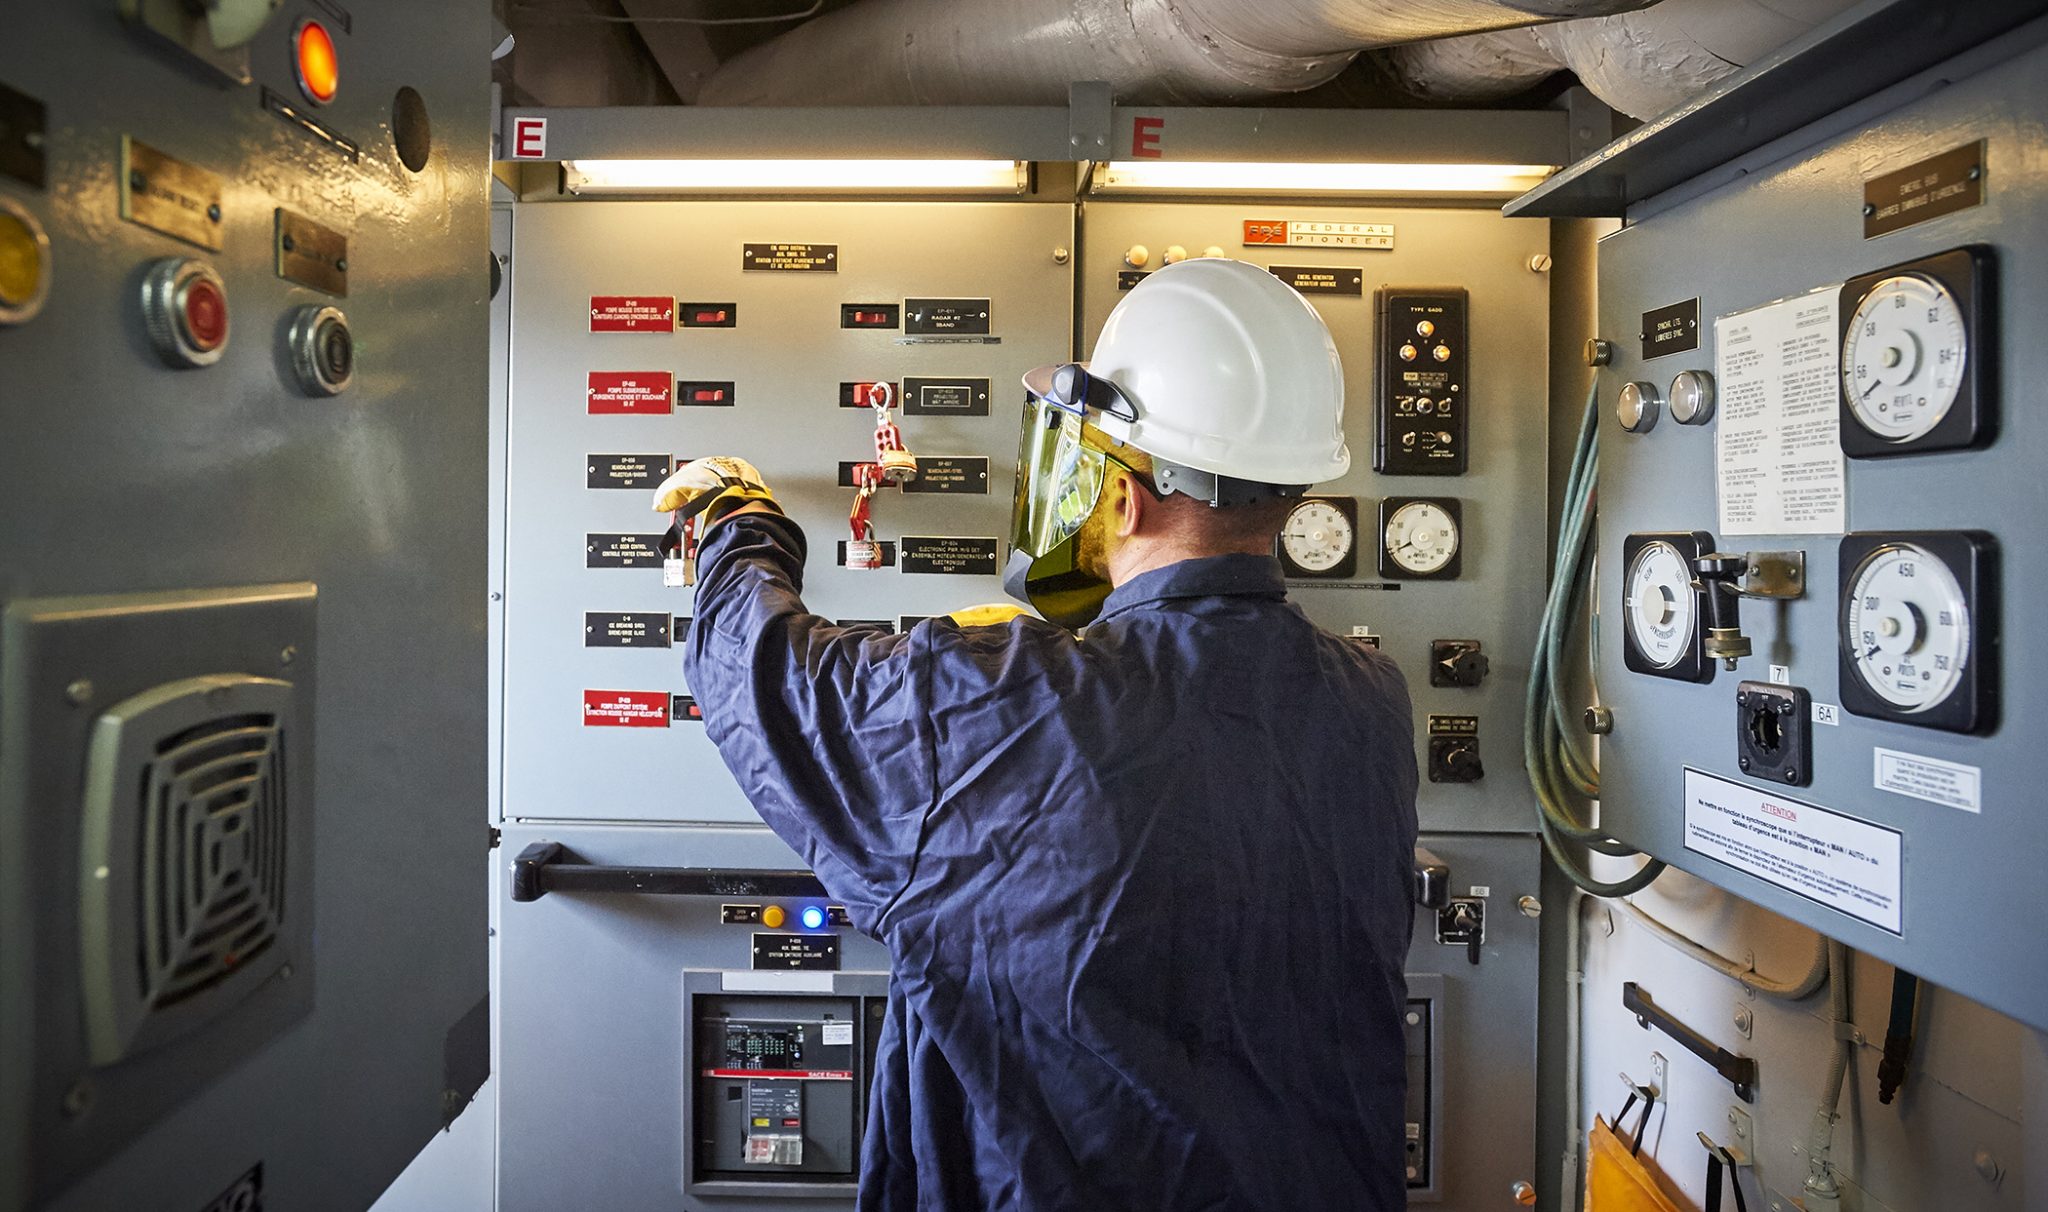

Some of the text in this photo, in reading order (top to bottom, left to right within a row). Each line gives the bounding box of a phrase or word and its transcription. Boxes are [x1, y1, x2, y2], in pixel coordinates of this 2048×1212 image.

[517, 122, 543, 156] E
[1132, 117, 1164, 158] E
[1296, 224, 1387, 233] FEDERAL
[1296, 236, 1388, 244] PIONEER
[1899, 563, 1915, 577] 450
[1865, 597, 1880, 610] 300
[1863, 631, 1875, 645] 150
[1776, 668, 1781, 680] 7
[1819, 707, 1832, 721] 6A
[1761, 803, 1796, 820] ATTENTION
[1723, 807, 1740, 817] fonction
[1746, 816, 1776, 830] synchroscope
[1793, 831, 1825, 846] l'interrupteur
[1831, 843, 1843, 852] MAN
[1848, 849, 1864, 860] AUTO
[1731, 818, 1747, 828] tableau
[1748, 824, 1770, 836] d'urgence
[1788, 839, 1808, 849] position
[1813, 846, 1825, 855] MAN
